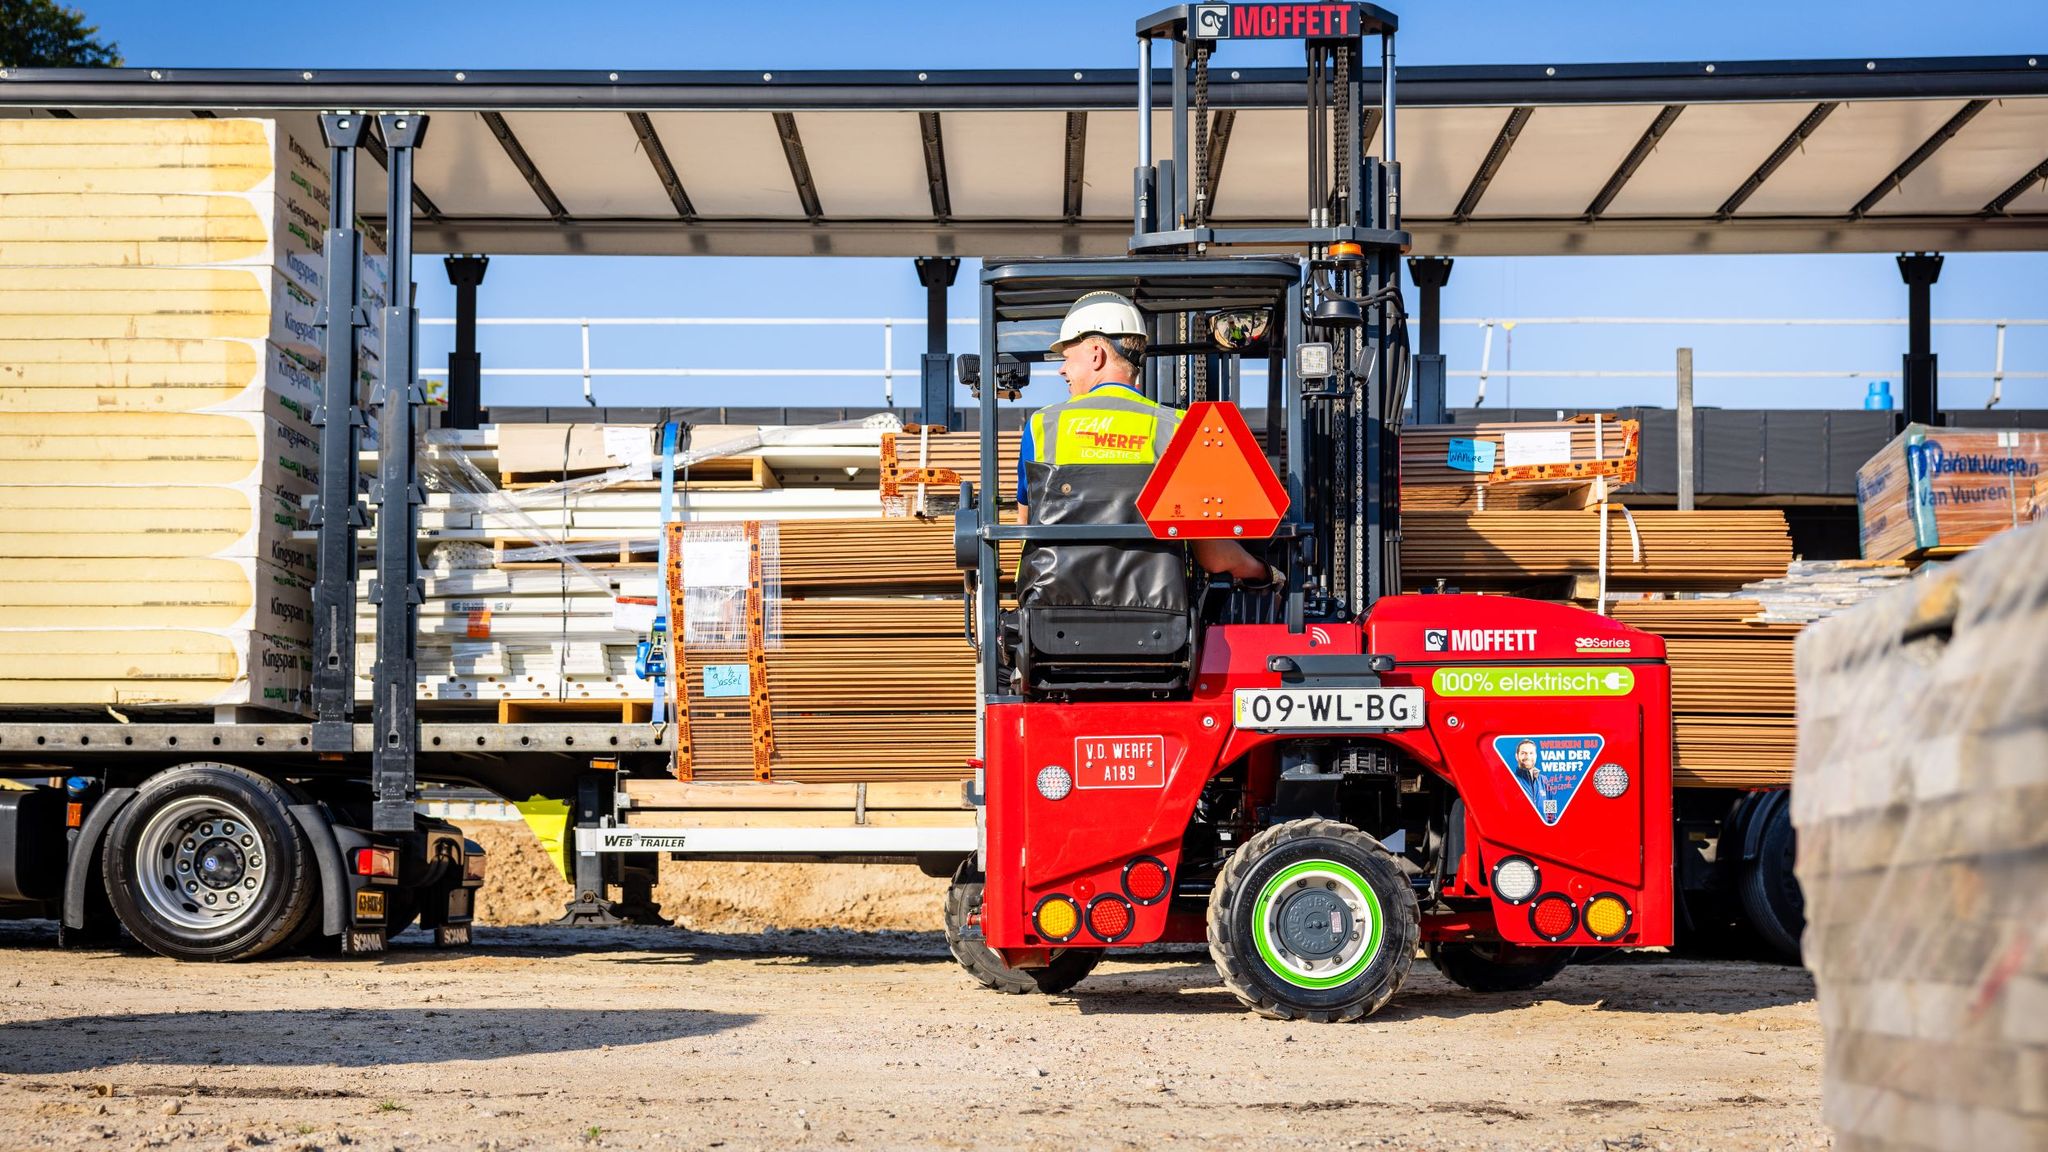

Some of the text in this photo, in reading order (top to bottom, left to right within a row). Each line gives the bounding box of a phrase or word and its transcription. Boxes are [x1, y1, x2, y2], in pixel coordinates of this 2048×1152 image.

[1234, 5, 1351, 36] MOFFETT
[286, 248, 318, 286] Kingspan
[284, 310, 317, 342] Kingspan
[1067, 416, 1114, 434] TEAM
[1094, 433, 1149, 449] WERFF
[1081, 447, 1140, 460] LOGISTICS
[1920, 484, 2008, 506] Van Vuuren
[271, 540, 304, 568] Kingspan
[271, 597, 304, 623] Kingspan
[1451, 629, 1537, 651] MOFFETT
[262, 649, 298, 674] Kingspan
[1439, 672, 1599, 692] 100% elektrisch
[1252, 694, 1408, 722] 09-WL-BG
[1086, 742, 1153, 759] V.D. WERFF
[1540, 740, 1581, 749] WERKEN
[1540, 749, 1591, 761] VAN DER
[1104, 765, 1136, 781] A189
[1541, 761, 1584, 772] WERFF?
[605, 835, 686, 848] WEB TRAILER
[353, 933, 383, 951] SCANIA
[444, 927, 469, 944] SCANIA
